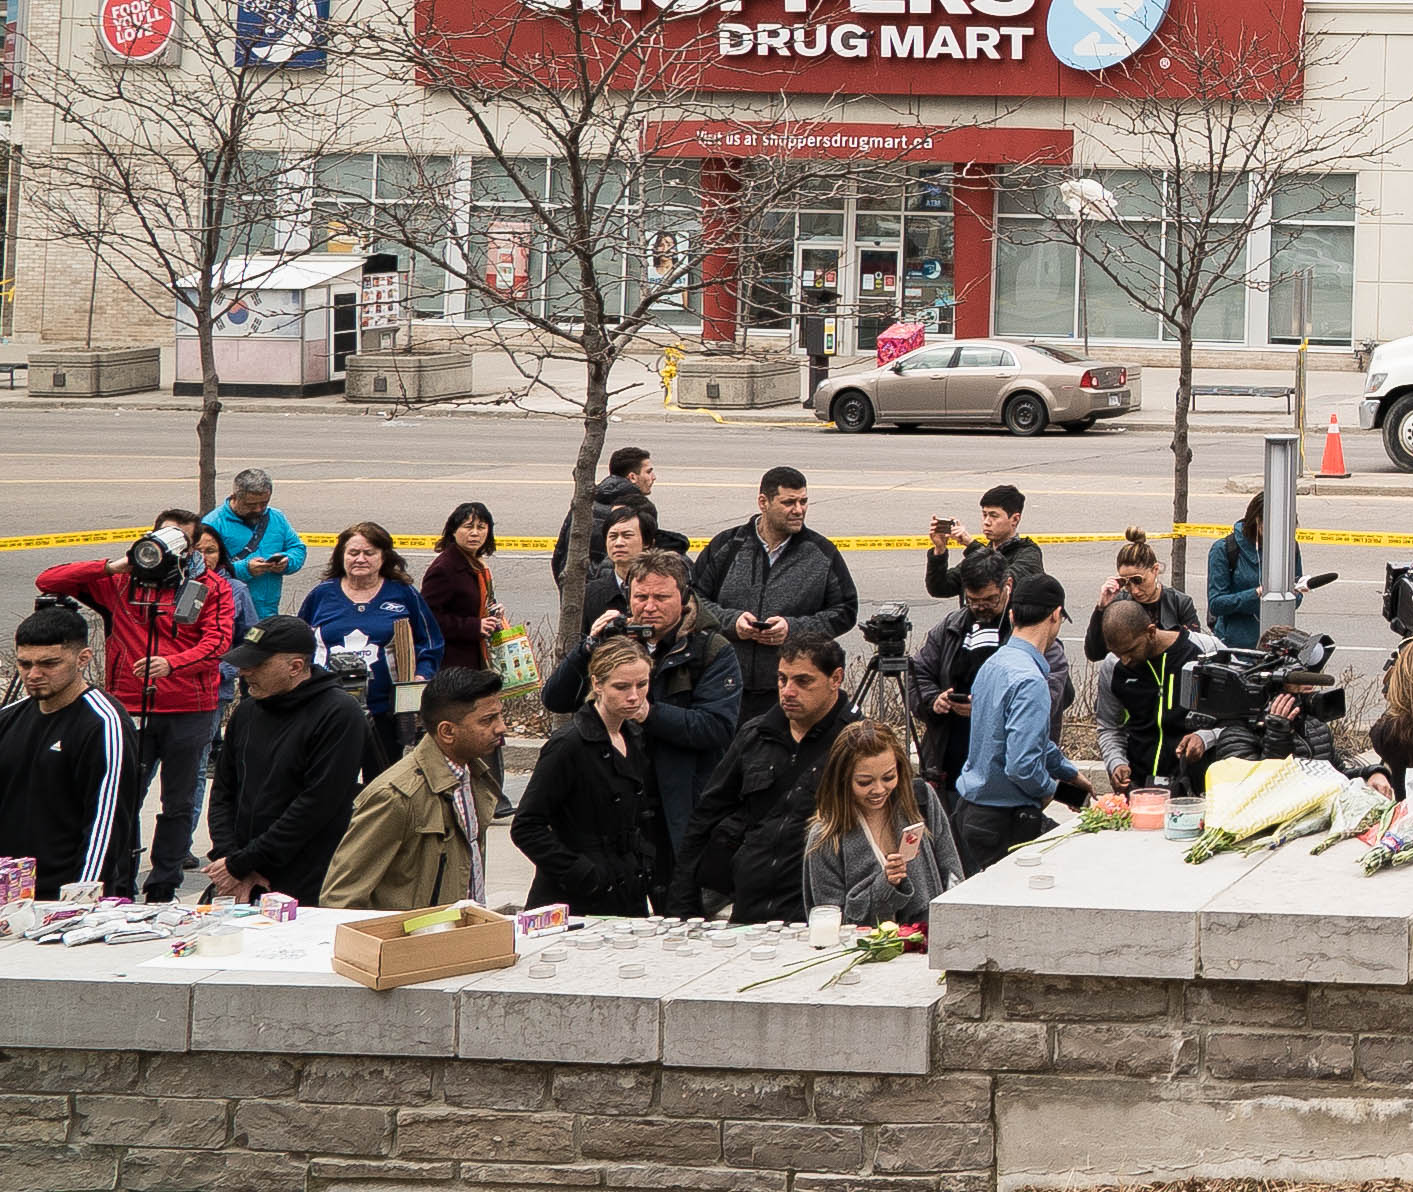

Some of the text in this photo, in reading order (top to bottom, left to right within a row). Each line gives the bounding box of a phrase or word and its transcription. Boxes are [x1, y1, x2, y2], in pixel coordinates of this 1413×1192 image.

[113, 11, 164, 33] YOU'LL
[116, 22, 154, 43] LOVE
[718, 22, 1035, 60] DRUG MART
[726, 134, 740, 145] us
[743, 133, 757, 146] at
[762, 132, 934, 151] shoppersdrugmart.ca
